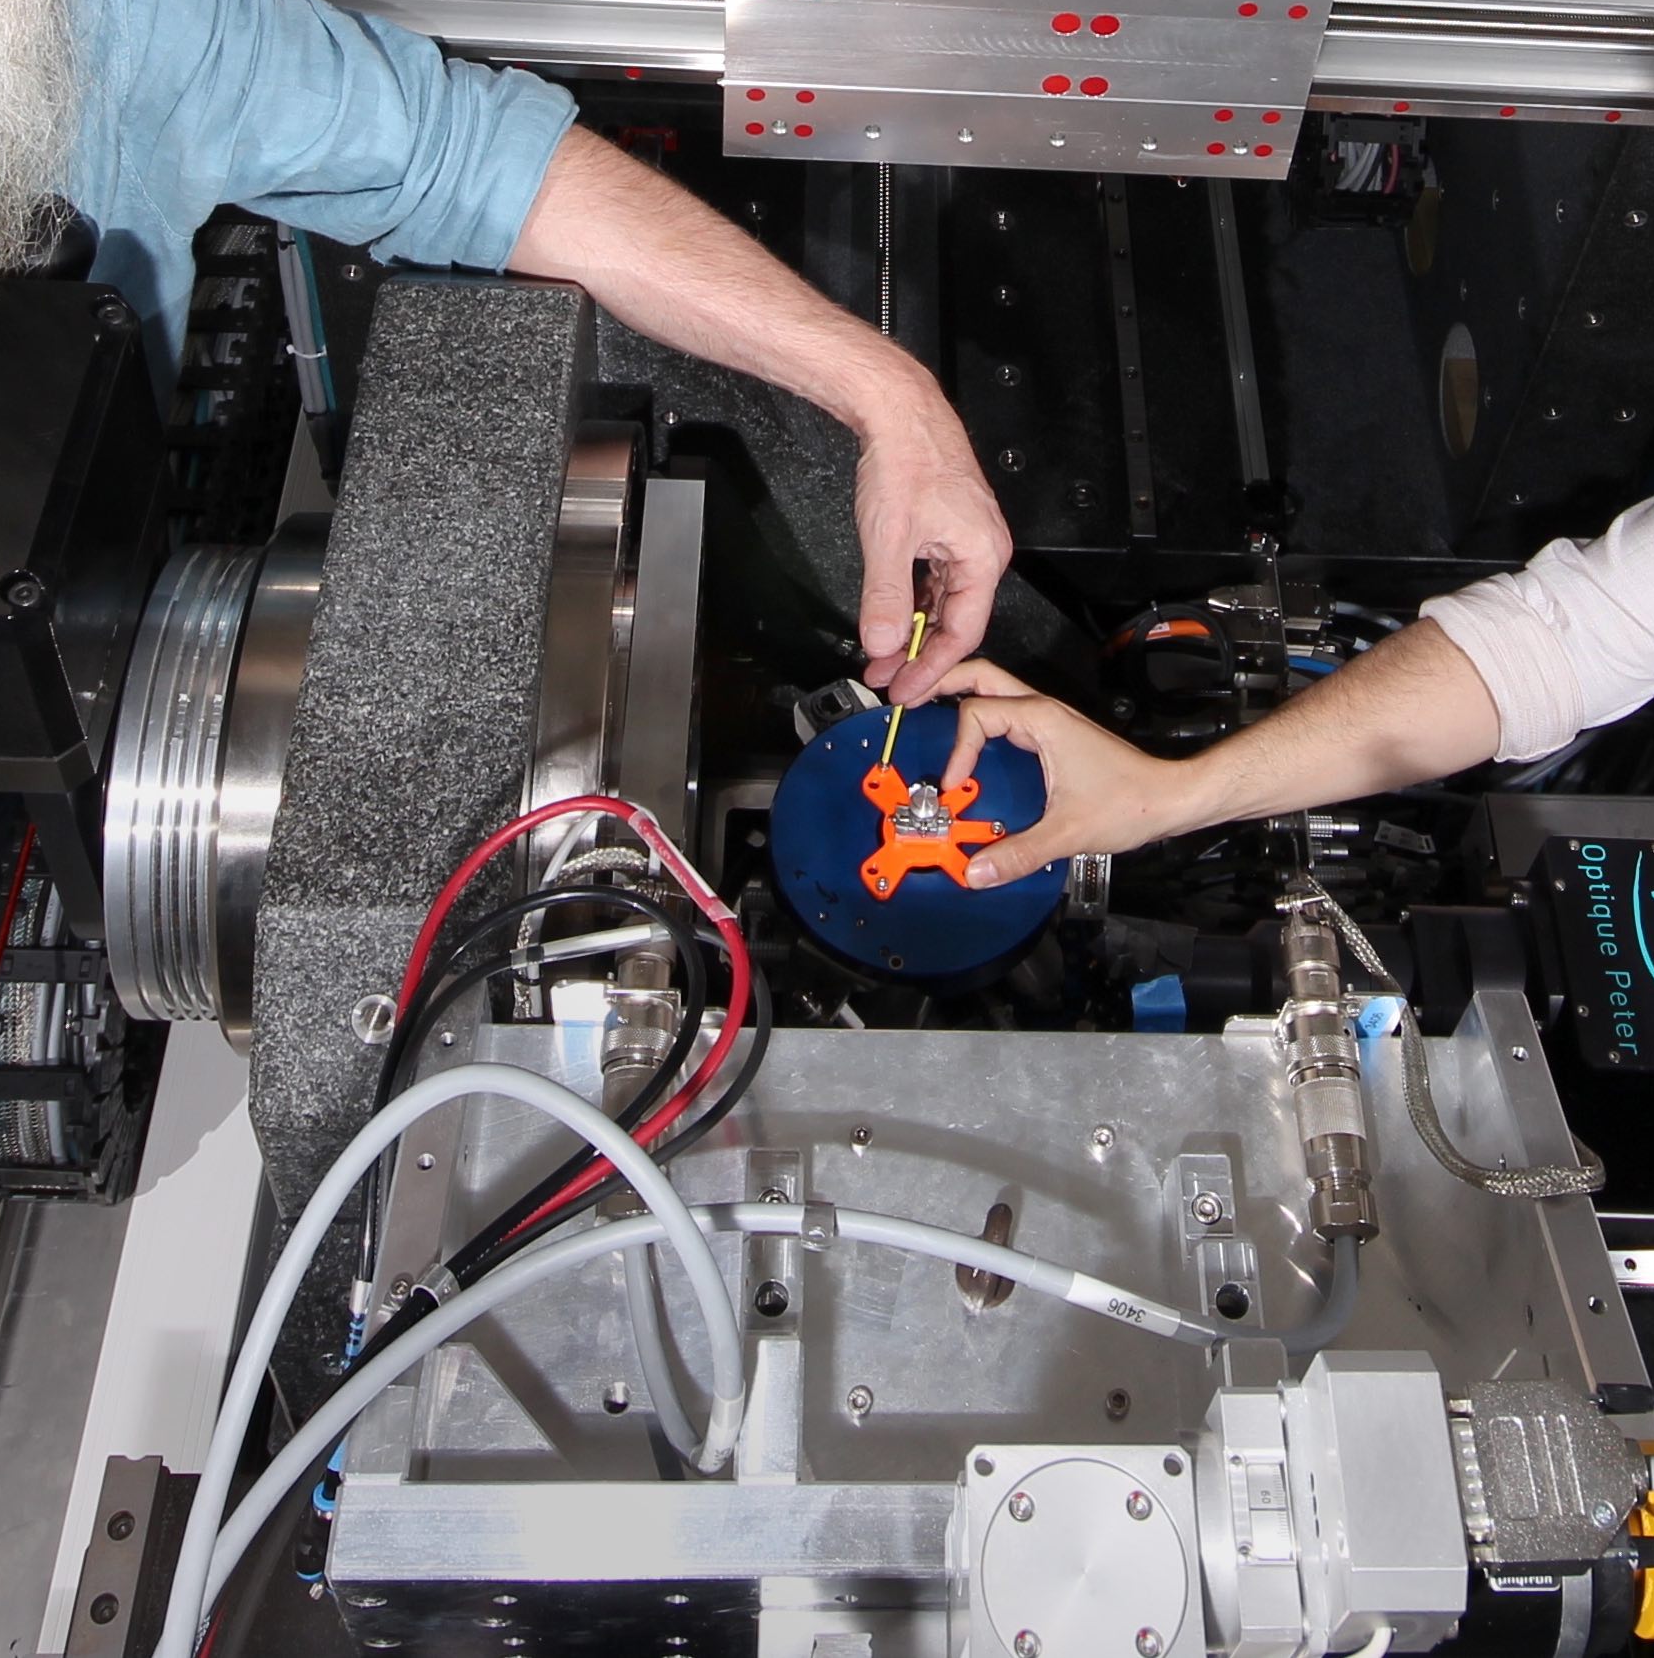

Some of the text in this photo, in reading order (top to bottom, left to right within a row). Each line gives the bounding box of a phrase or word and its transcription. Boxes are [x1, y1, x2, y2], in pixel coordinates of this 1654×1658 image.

[1578, 844, 1638, 1056] Optique Peter
[1107, 1297, 1147, 1323] 3406
